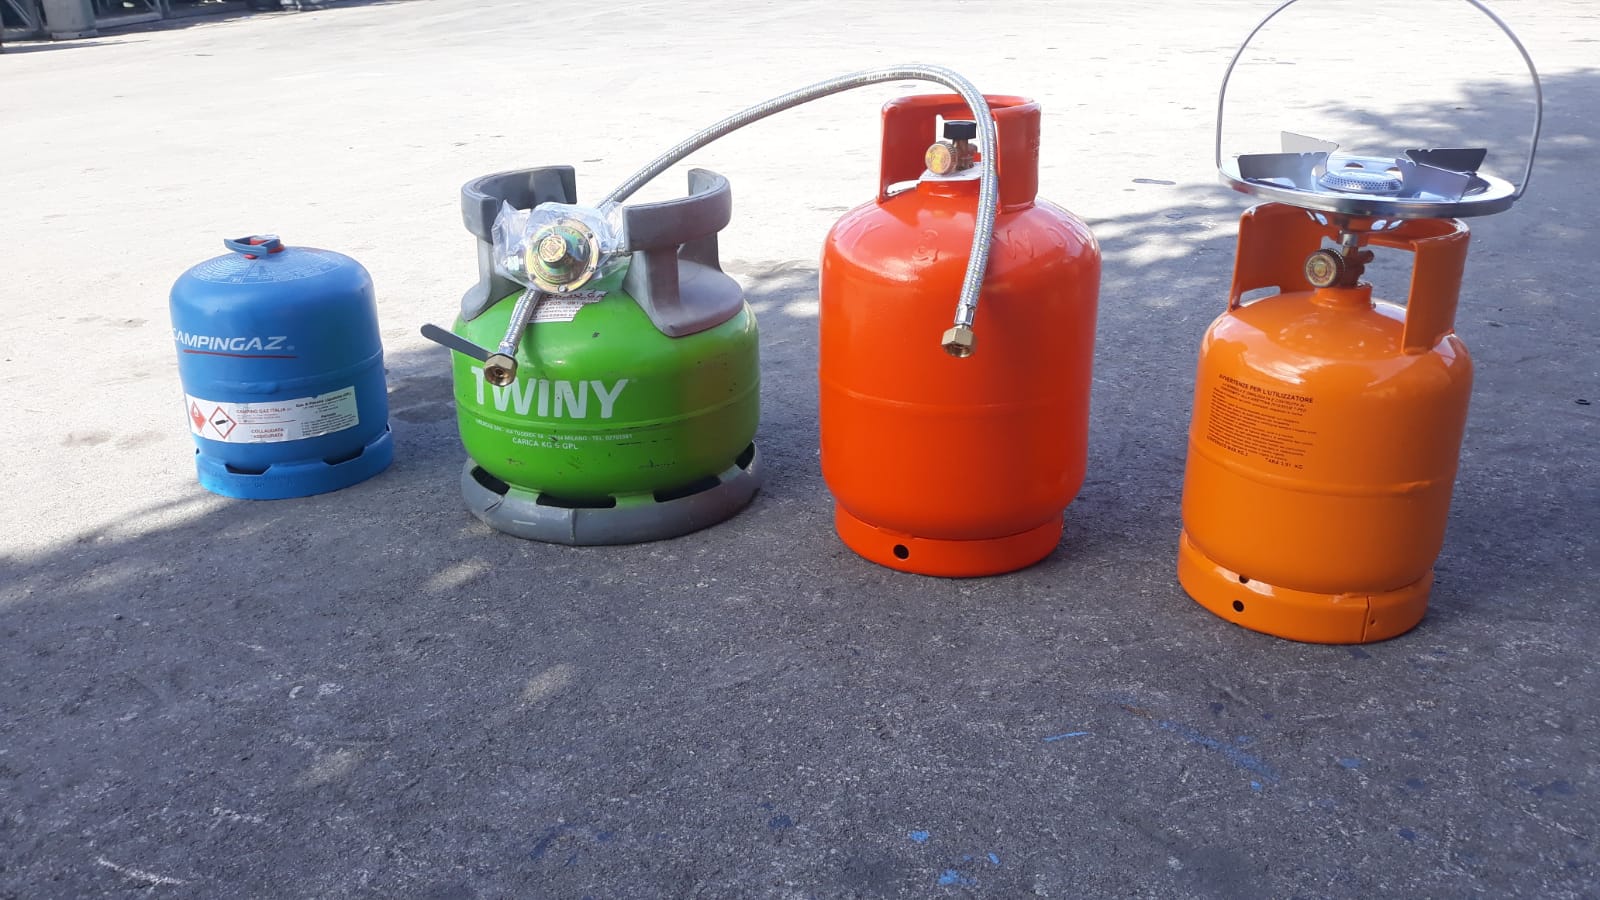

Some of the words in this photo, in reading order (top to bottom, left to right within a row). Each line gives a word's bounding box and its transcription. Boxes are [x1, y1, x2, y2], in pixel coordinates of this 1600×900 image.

[471, 365, 629, 419] TWINY
[1250, 385, 1261, 393] PER
[512, 437, 539, 447] CARICA
